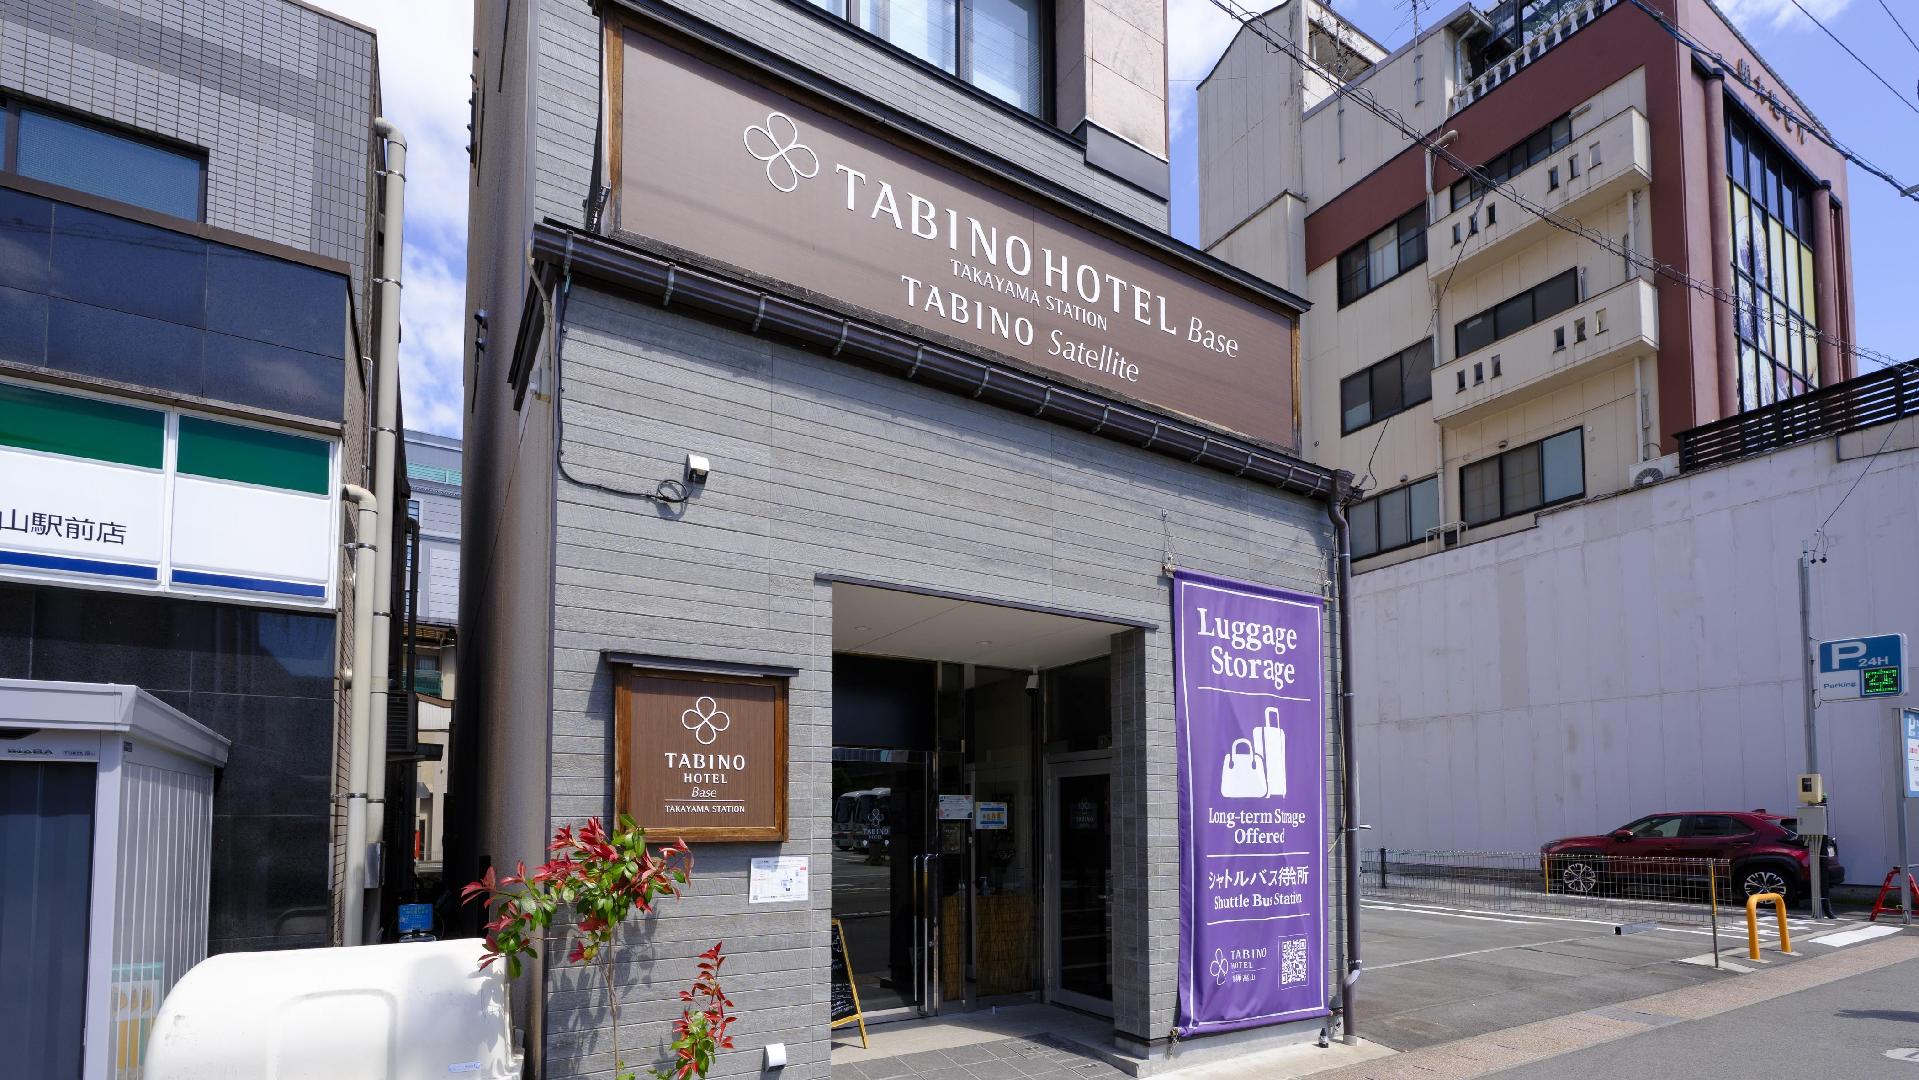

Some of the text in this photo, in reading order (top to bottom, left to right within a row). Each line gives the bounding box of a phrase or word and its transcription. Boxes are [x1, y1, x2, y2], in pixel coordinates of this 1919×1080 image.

[834, 163, 1239, 358] TABINO HOTEL Base
[950, 258, 1107, 331] TAKAYAMA STATION
[900, 275, 1139, 382] TABINO Satellite
[1196, 607, 1297, 655] Luggage
[1211, 645, 1295, 690] Storage
[1858, 656, 1889, 667] 24H
[664, 752, 746, 770] TABINO
[683, 773, 728, 784] HOTEL
[691, 786, 717, 798] Base
[664, 805, 745, 813] TAKAYAMA STATION
[1208, 807, 1273, 829] Long-term
[1234, 827, 1285, 844] Offered
[1208, 865, 1310, 890] シャトルバス待合所
[1214, 893, 1250, 910] Shuttle
[1252, 893, 1273, 907] Bus
[1230, 947, 1267, 960] TABINO
